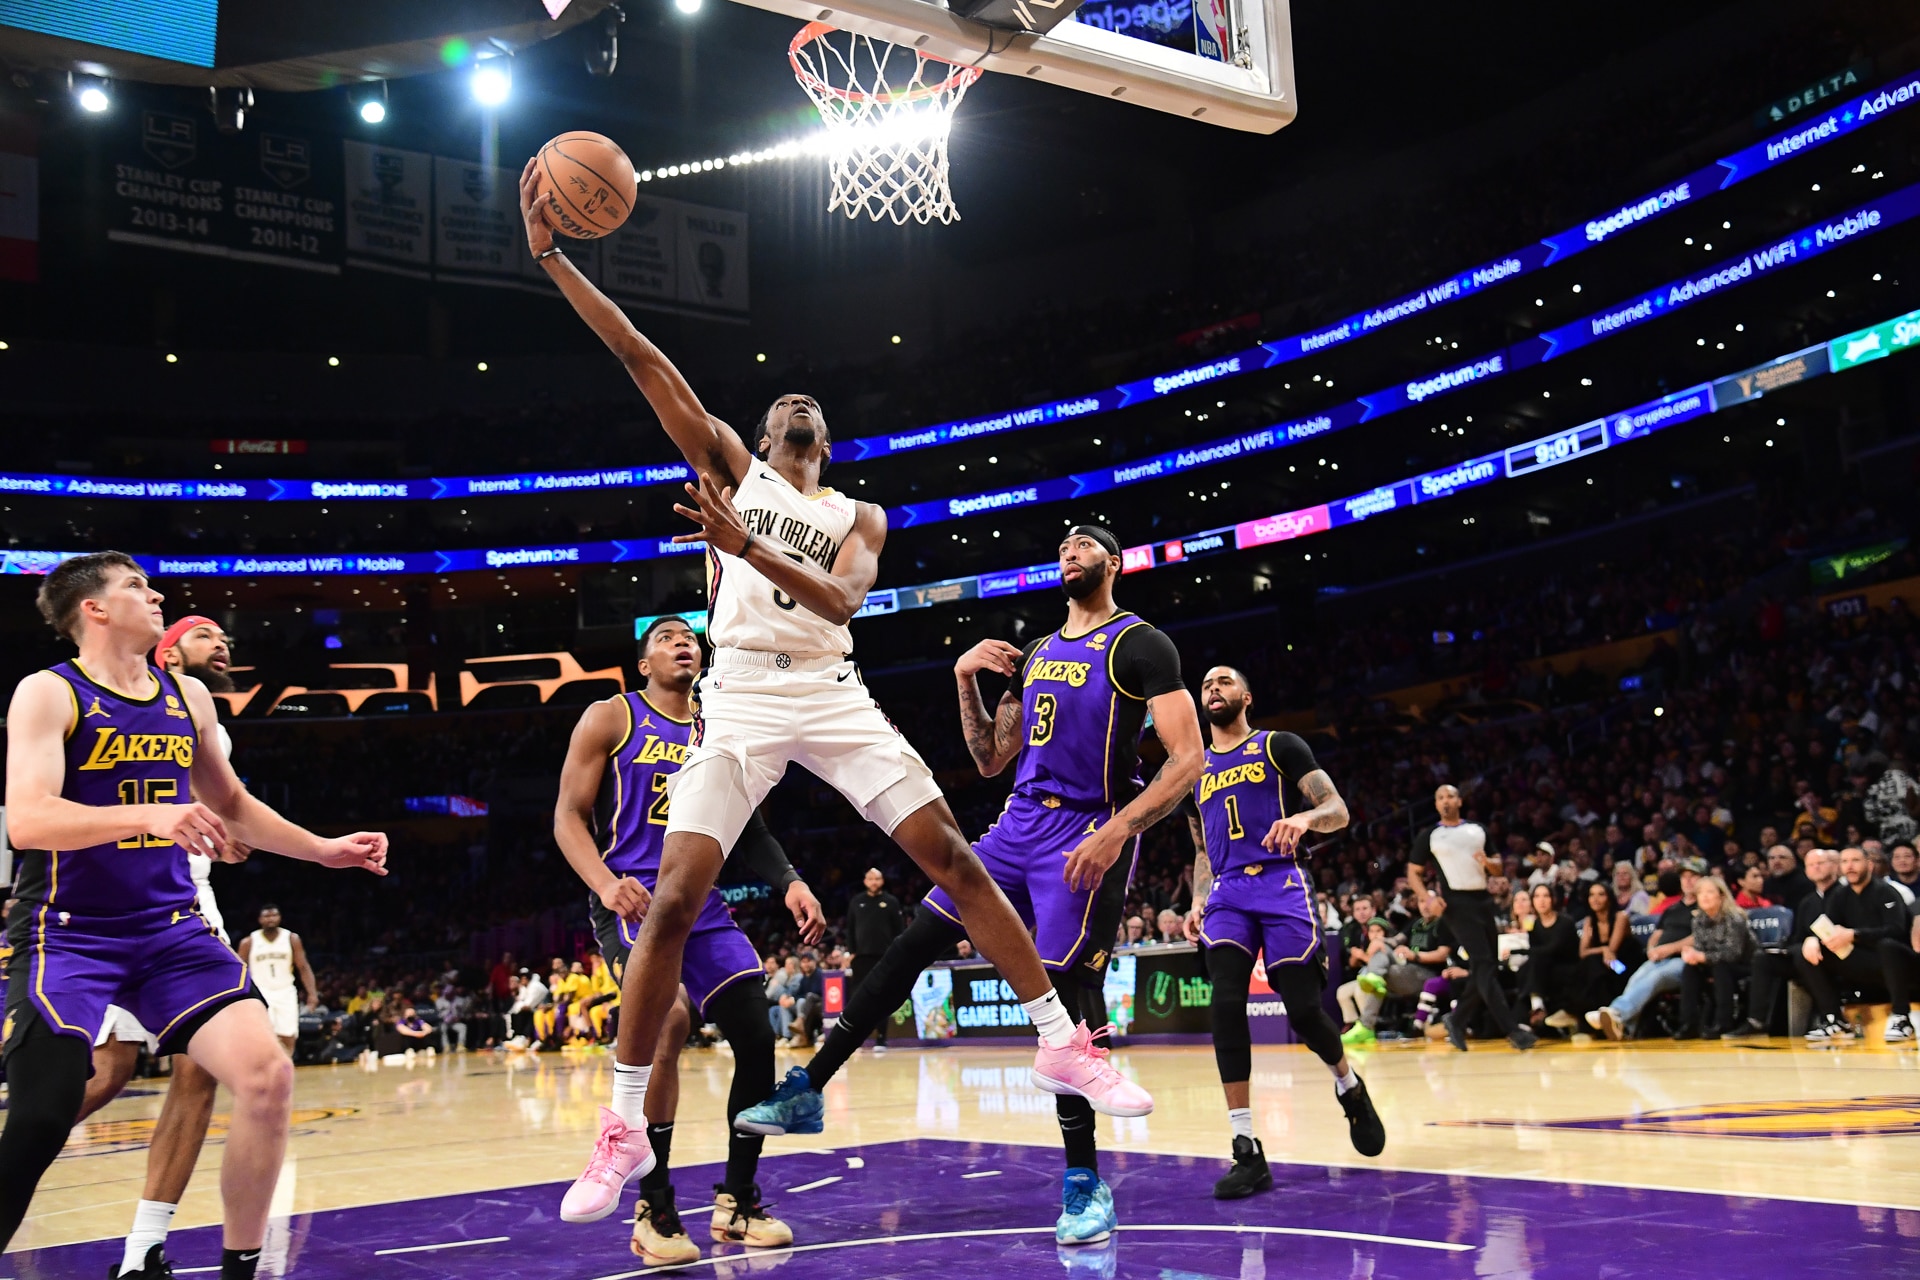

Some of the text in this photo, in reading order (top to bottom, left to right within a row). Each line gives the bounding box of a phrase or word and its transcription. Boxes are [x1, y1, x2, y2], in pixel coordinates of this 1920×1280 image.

[1200, 39, 1218, 57] NBA
[1788, 70, 1857, 113] DELTA
[1767, 116, 1839, 161] Internet
[116, 163, 222, 194] STANLEY CUP
[116, 180, 223, 212] CHAMPIONS
[235, 186, 334, 214] STANLEY CUP
[131, 206, 208, 236] 2013-14
[235, 202, 334, 232] CHAMPIONS
[250, 226, 319, 254] 2011-12
[1592, 210, 1881, 335] Internet Advanced WiFi Mobile
[1301, 258, 1521, 353] Internet Advanced WiFi Mobile
[889, 398, 1099, 450] Internet Advanced WiFi Mobile
[1634, 396, 1701, 428] crypto.com
[1114, 416, 1332, 483] Internet Advanced WiFi Mobile
[1534, 432, 1581, 465] 9:01
[67, 479, 145, 497] Advanced
[147, 483, 182, 496] WiFi
[197, 483, 247, 497] Mobile
[469, 465, 688, 493] Internet Advanced WiFi Mobile
[1421, 461, 1494, 495] Spectrum
[1253, 513, 1314, 540] boldyn
[1183, 537, 1224, 554] TOYOTA
[159, 557, 405, 574] Internet Advanced WiFi Mobile
[1829, 598, 1861, 618] 101
[1023, 656, 1091, 688] LAKERS
[1029, 693, 1057, 746] 3
[78, 727, 194, 771] LAKERS
[1199, 761, 1266, 805] LAKERS
[117, 778, 178, 850] 15
[1225, 794, 1244, 840] 1
[969, 979, 999, 1002] THE
[957, 1005, 999, 1027] GAME
